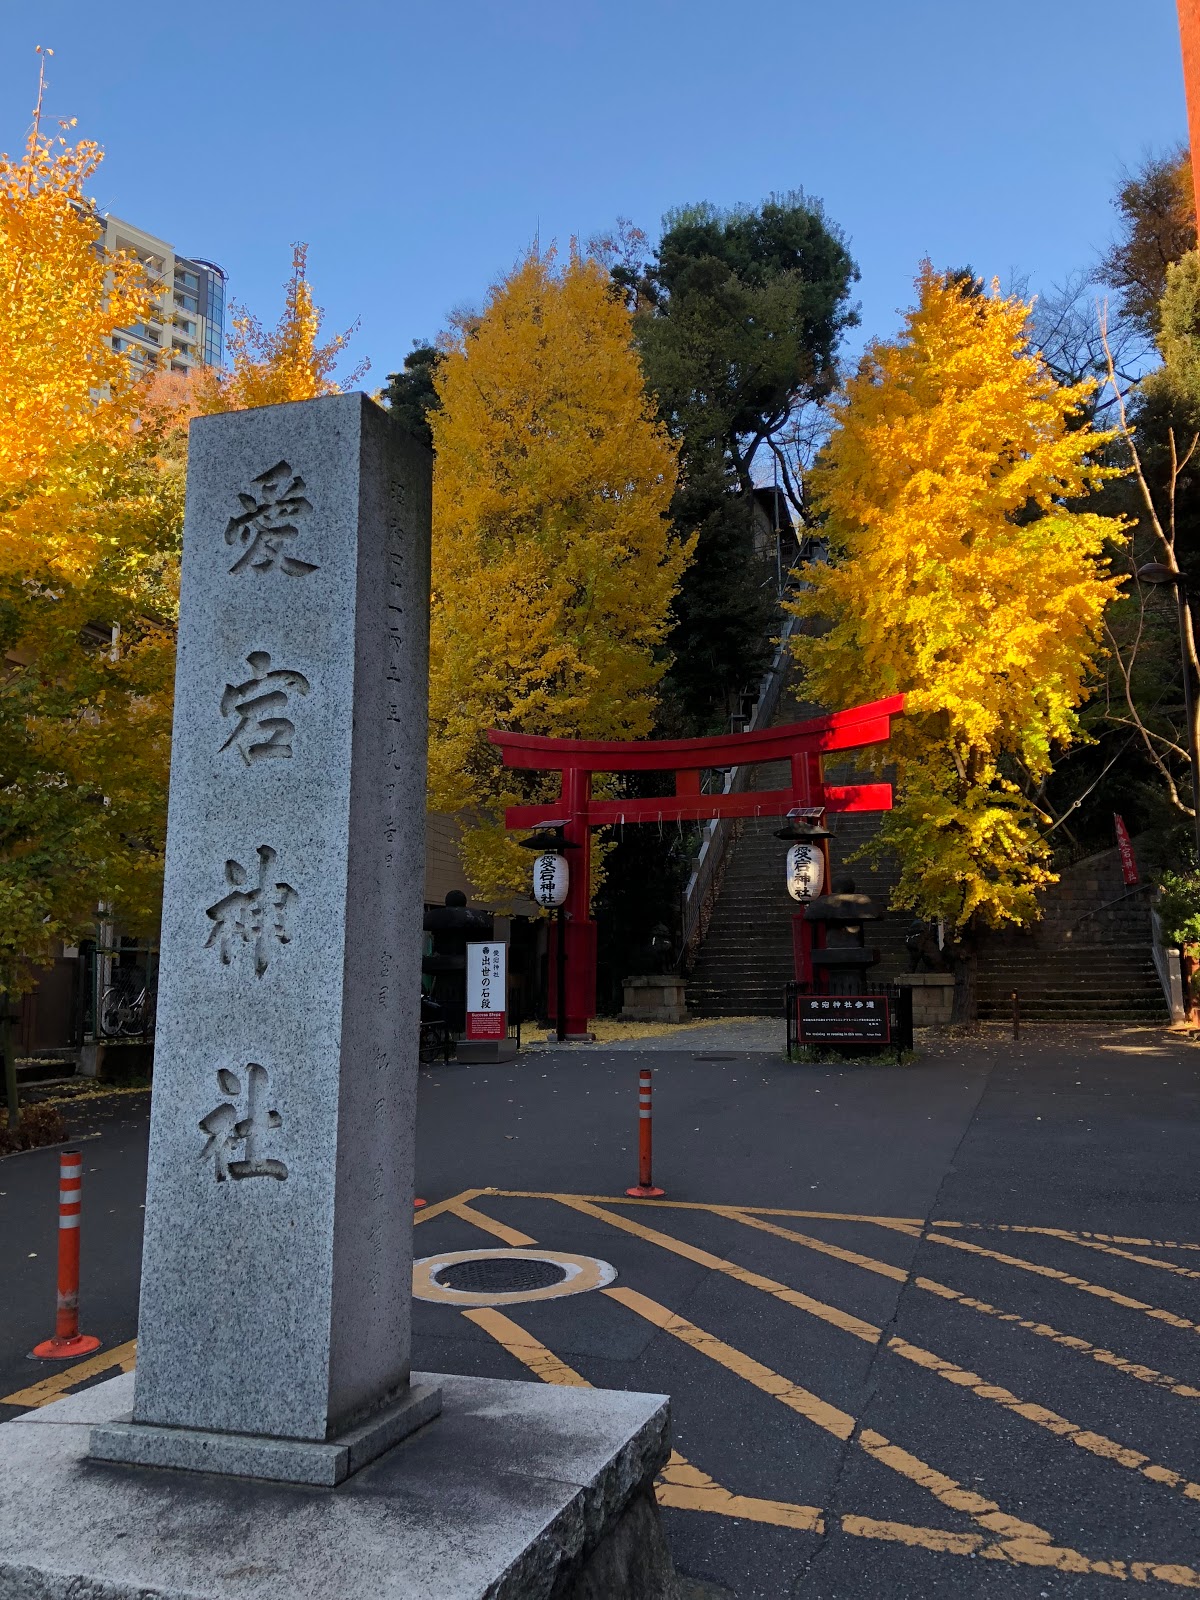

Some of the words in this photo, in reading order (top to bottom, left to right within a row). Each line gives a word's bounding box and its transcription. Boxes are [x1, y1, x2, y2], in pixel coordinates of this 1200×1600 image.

[199, 459, 321, 1183] 愛宕神社
[540, 855, 557, 904] 愛宕神社
[794, 846, 812, 898] 愛宕神社
[481, 956, 491, 1009] 出世の石段
[492, 949, 500, 978] 愛宕神社
[810, 1001, 875, 1009] 愛宕神社参道
